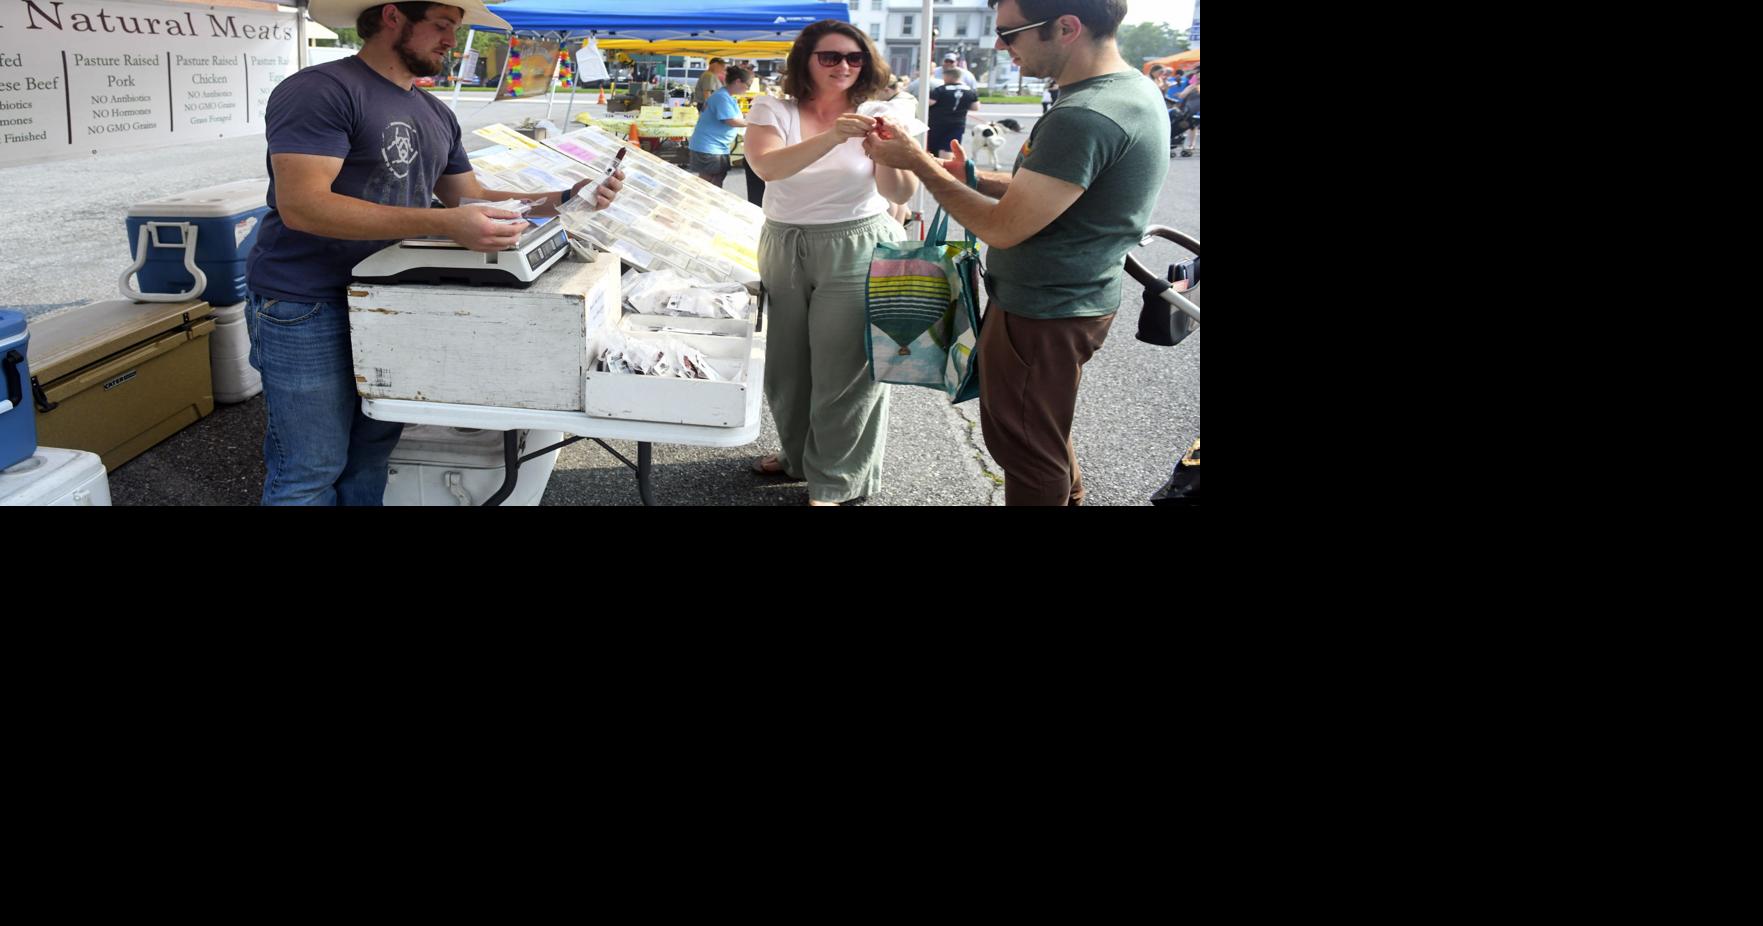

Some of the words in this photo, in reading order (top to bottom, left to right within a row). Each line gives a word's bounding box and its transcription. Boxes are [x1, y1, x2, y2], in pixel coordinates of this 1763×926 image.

[21, 0, 198, 37] Natural
[205, 14, 292, 40] Meats
[74, 53, 120, 66] Pasture
[123, 54, 160, 66] Raised
[175, 55, 209, 66] Pasture
[212, 55, 239, 66] Raised
[25, 76, 60, 90] Beef
[107, 75, 136, 87] Pork
[192, 73, 228, 84] Chicken
[91, 95, 108, 104] NO
[187, 90, 201, 99] NO
[93, 109, 109, 119] NO
[88, 125, 104, 135] NO
[107, 122, 131, 132] GMO
[4, 131, 47, 143] Finished
